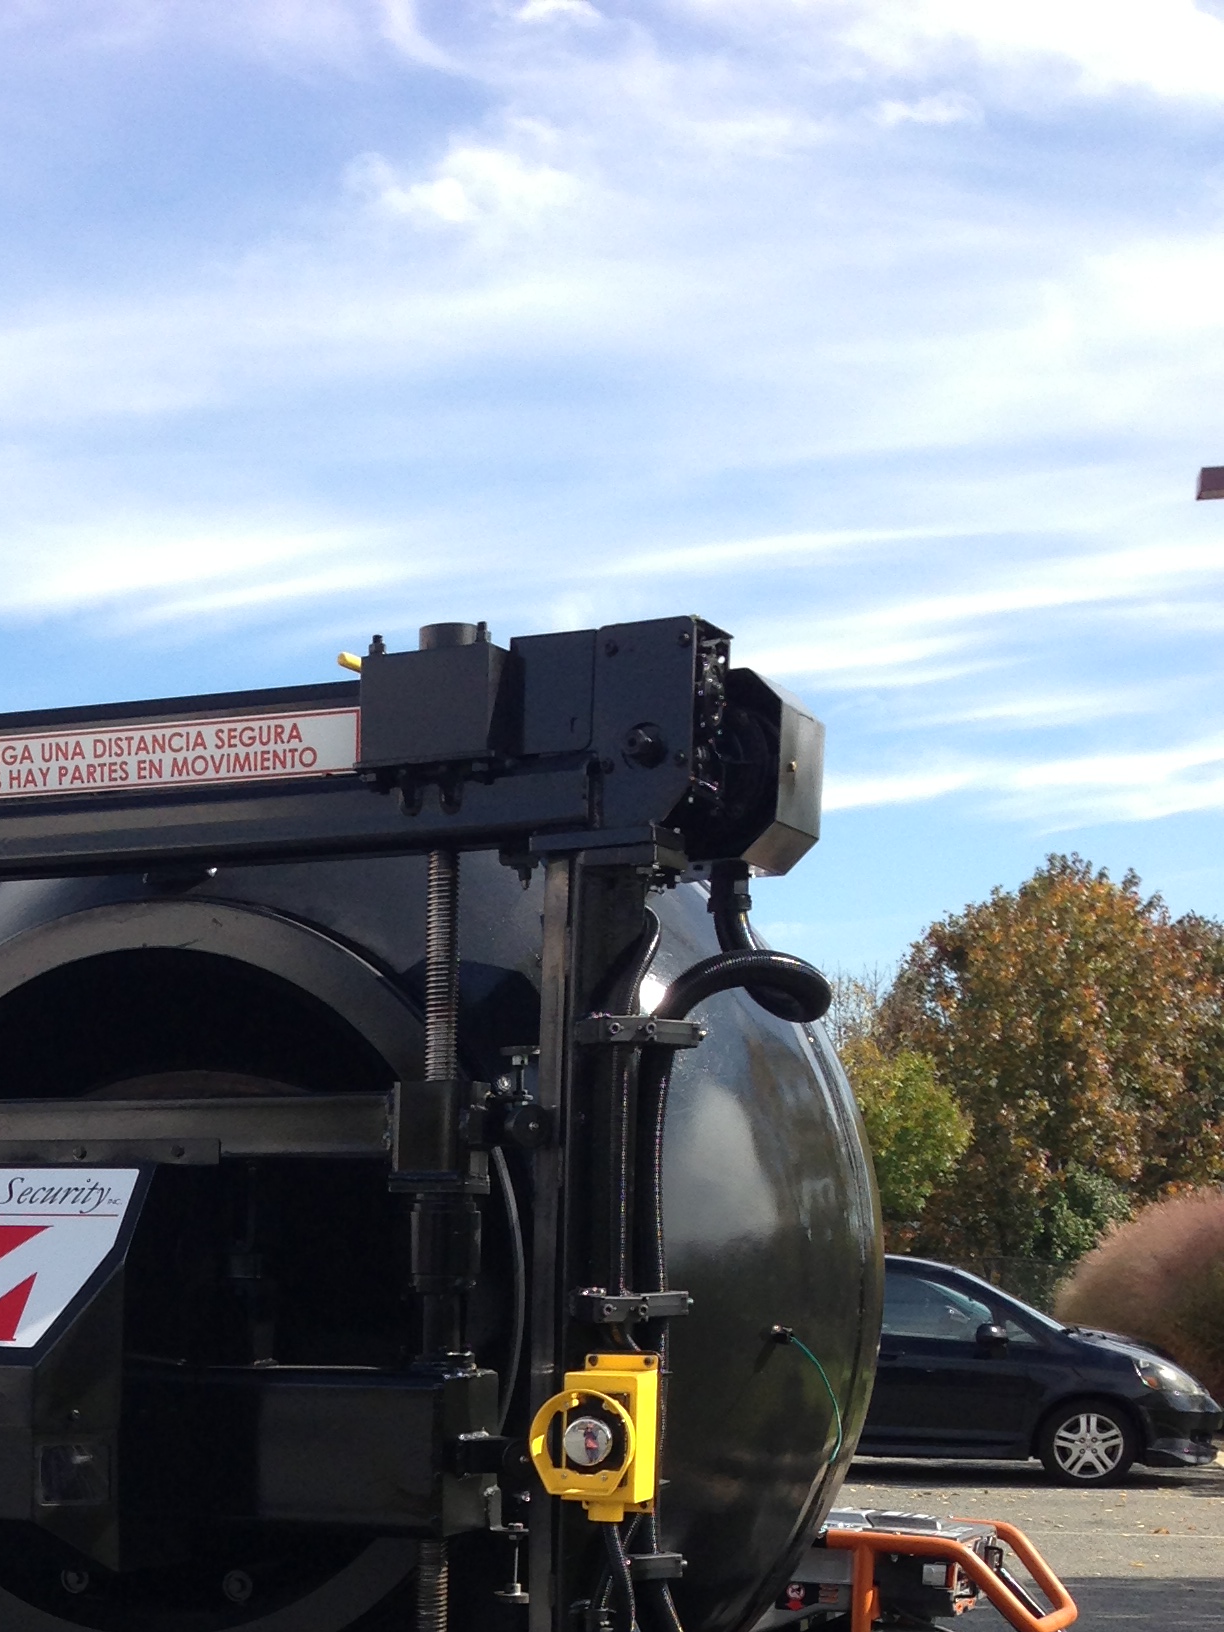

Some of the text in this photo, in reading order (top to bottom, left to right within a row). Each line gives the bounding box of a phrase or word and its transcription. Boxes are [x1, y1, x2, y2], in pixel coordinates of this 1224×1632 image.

[41, 740, 86, 763] UNA
[93, 730, 208, 760] DISTANCIA
[214, 722, 304, 751] SEGURA
[8, 766, 51, 790] HAY
[57, 760, 130, 786] PARTES
[136, 758, 164, 780] EN
[169, 746, 318, 778] MOVIMIENTO
